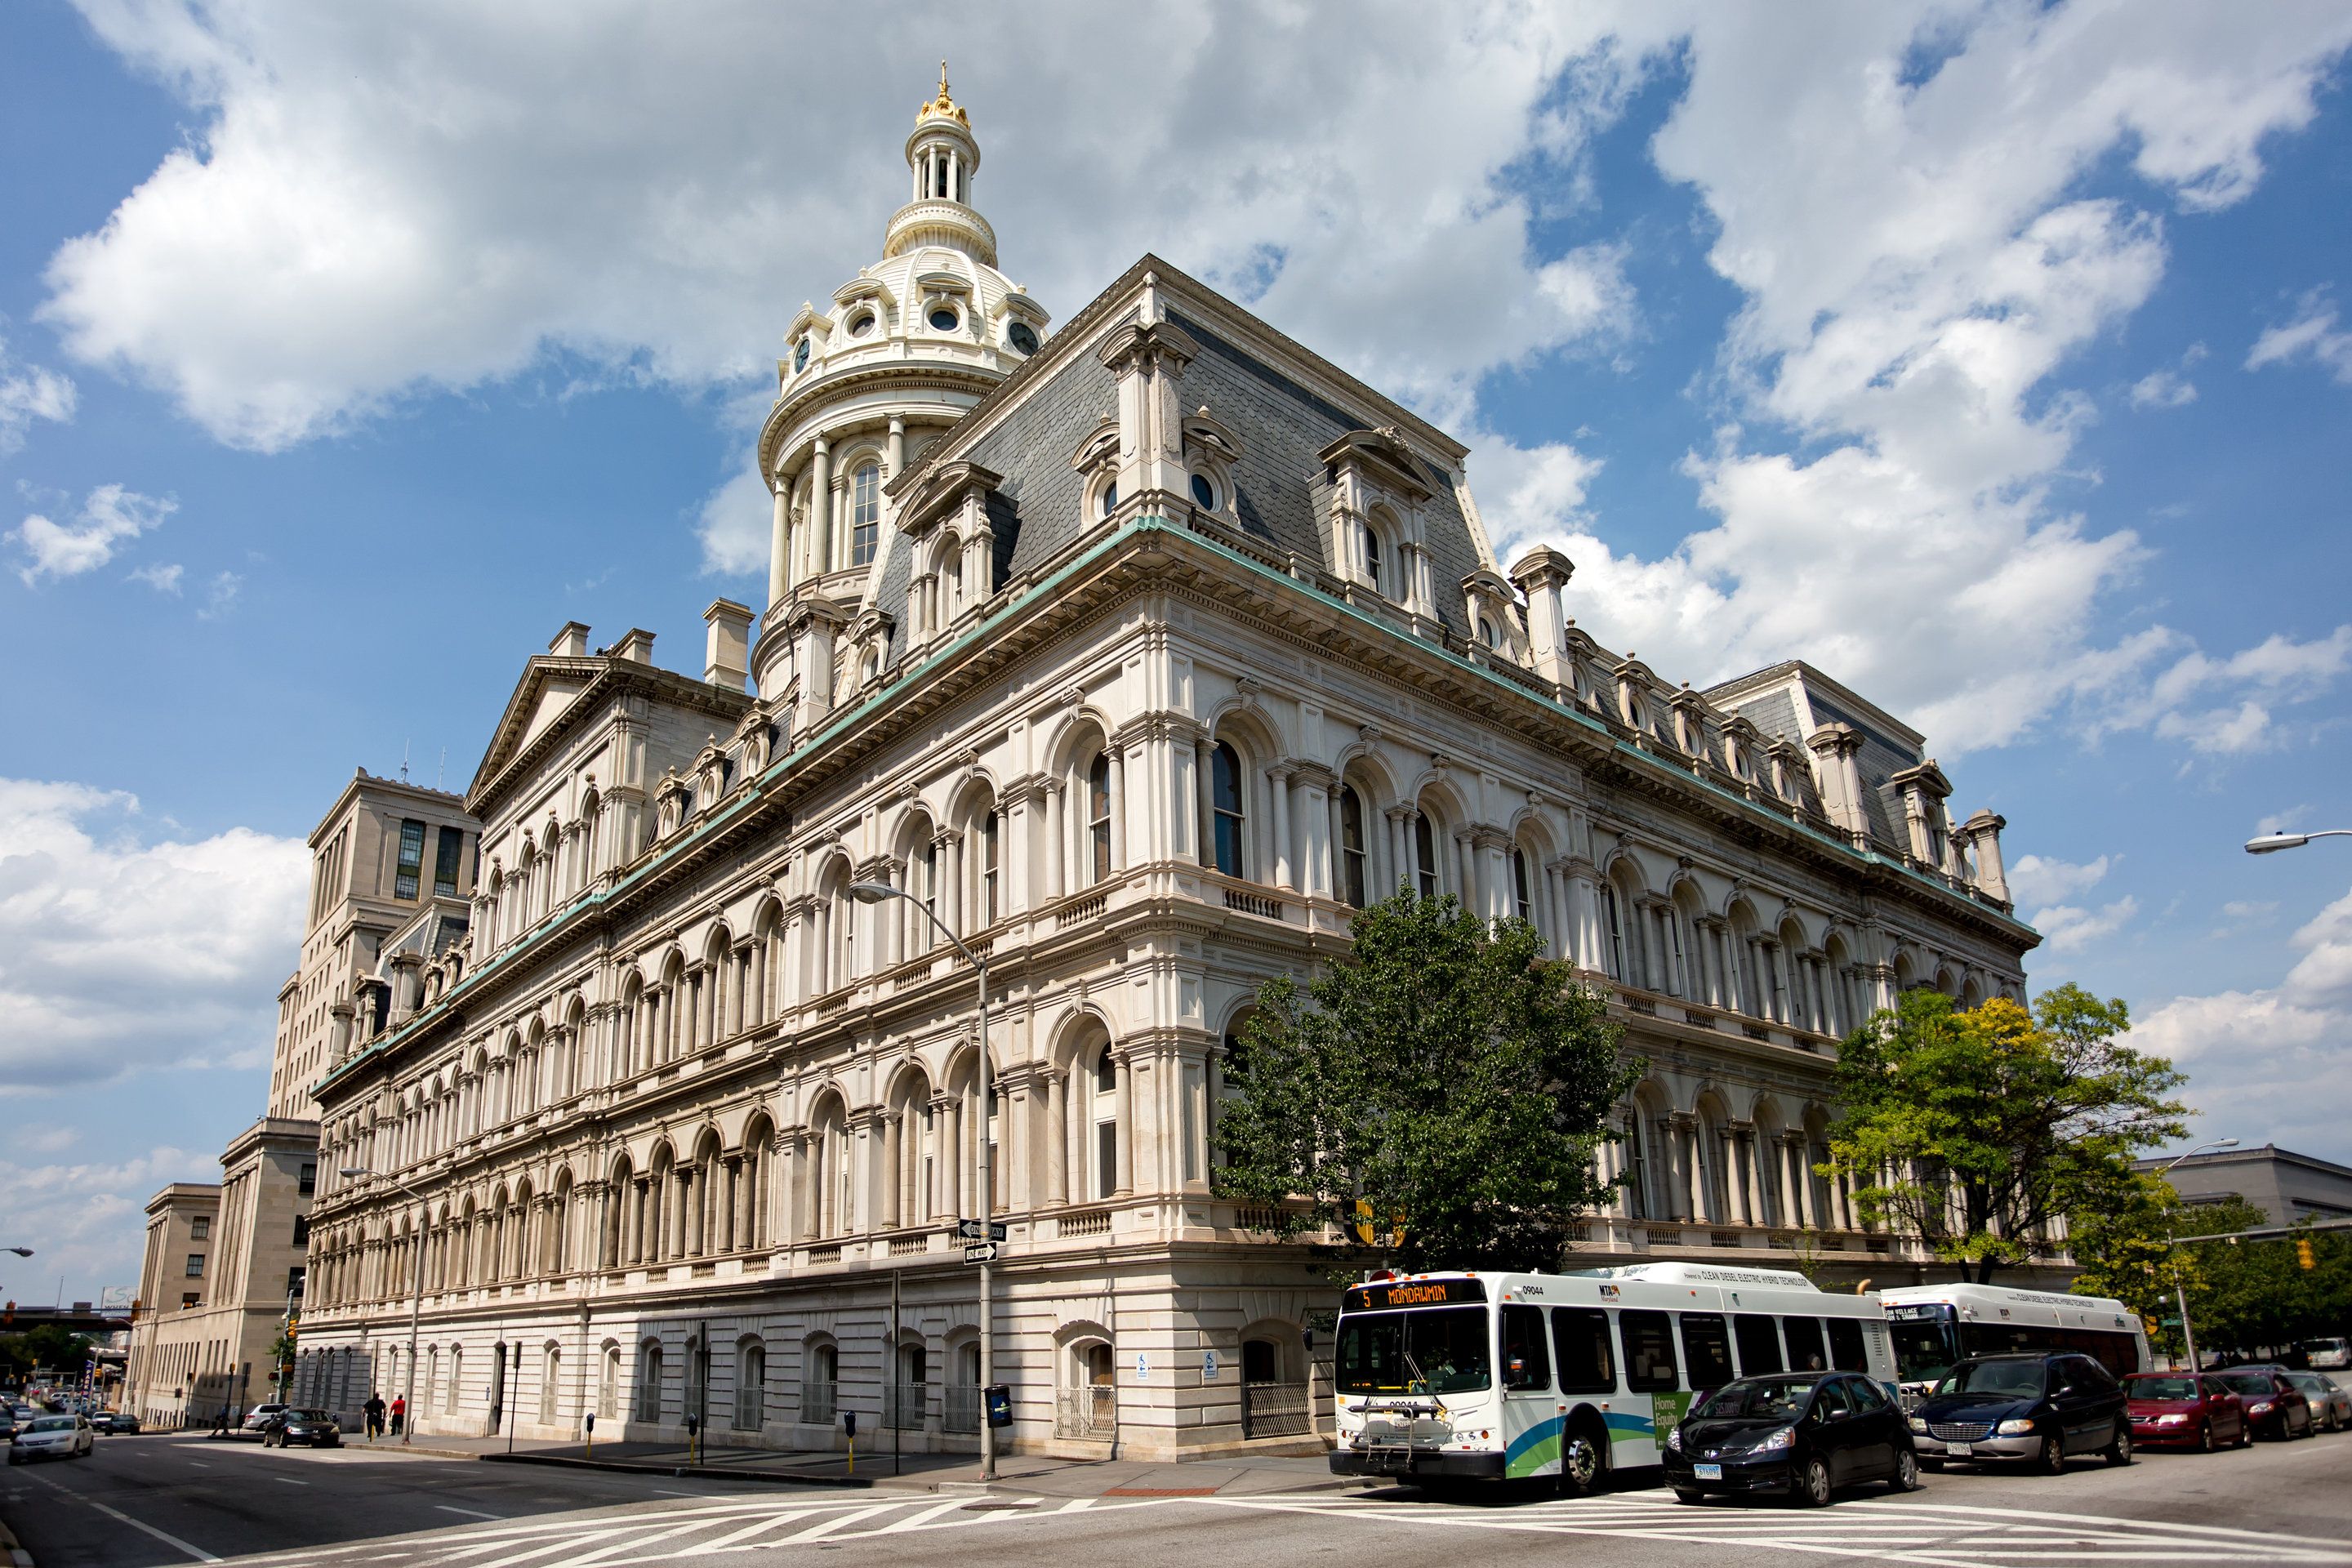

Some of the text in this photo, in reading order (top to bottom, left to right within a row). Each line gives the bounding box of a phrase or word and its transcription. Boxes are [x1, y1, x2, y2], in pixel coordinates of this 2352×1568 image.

[968, 1249, 987, 1258] ONE WAY
[1701, 1271, 1720, 1281] CLEAN
[1720, 1272, 1738, 1282] DIESEL
[1738, 1273, 1761, 1284] ELECTRIC
[1761, 1275, 1780, 1285] HYBRID
[1779, 1276, 1808, 1287] TECHNOLOGY
[1363, 1285, 1446, 1307] 5 MONDAWMIN
[1522, 1285, 1544, 1295] 09044
[1599, 1285, 1613, 1297] MTA
[1655, 1397, 1677, 1410] Home
[1655, 1413, 1678, 1429] Equity
